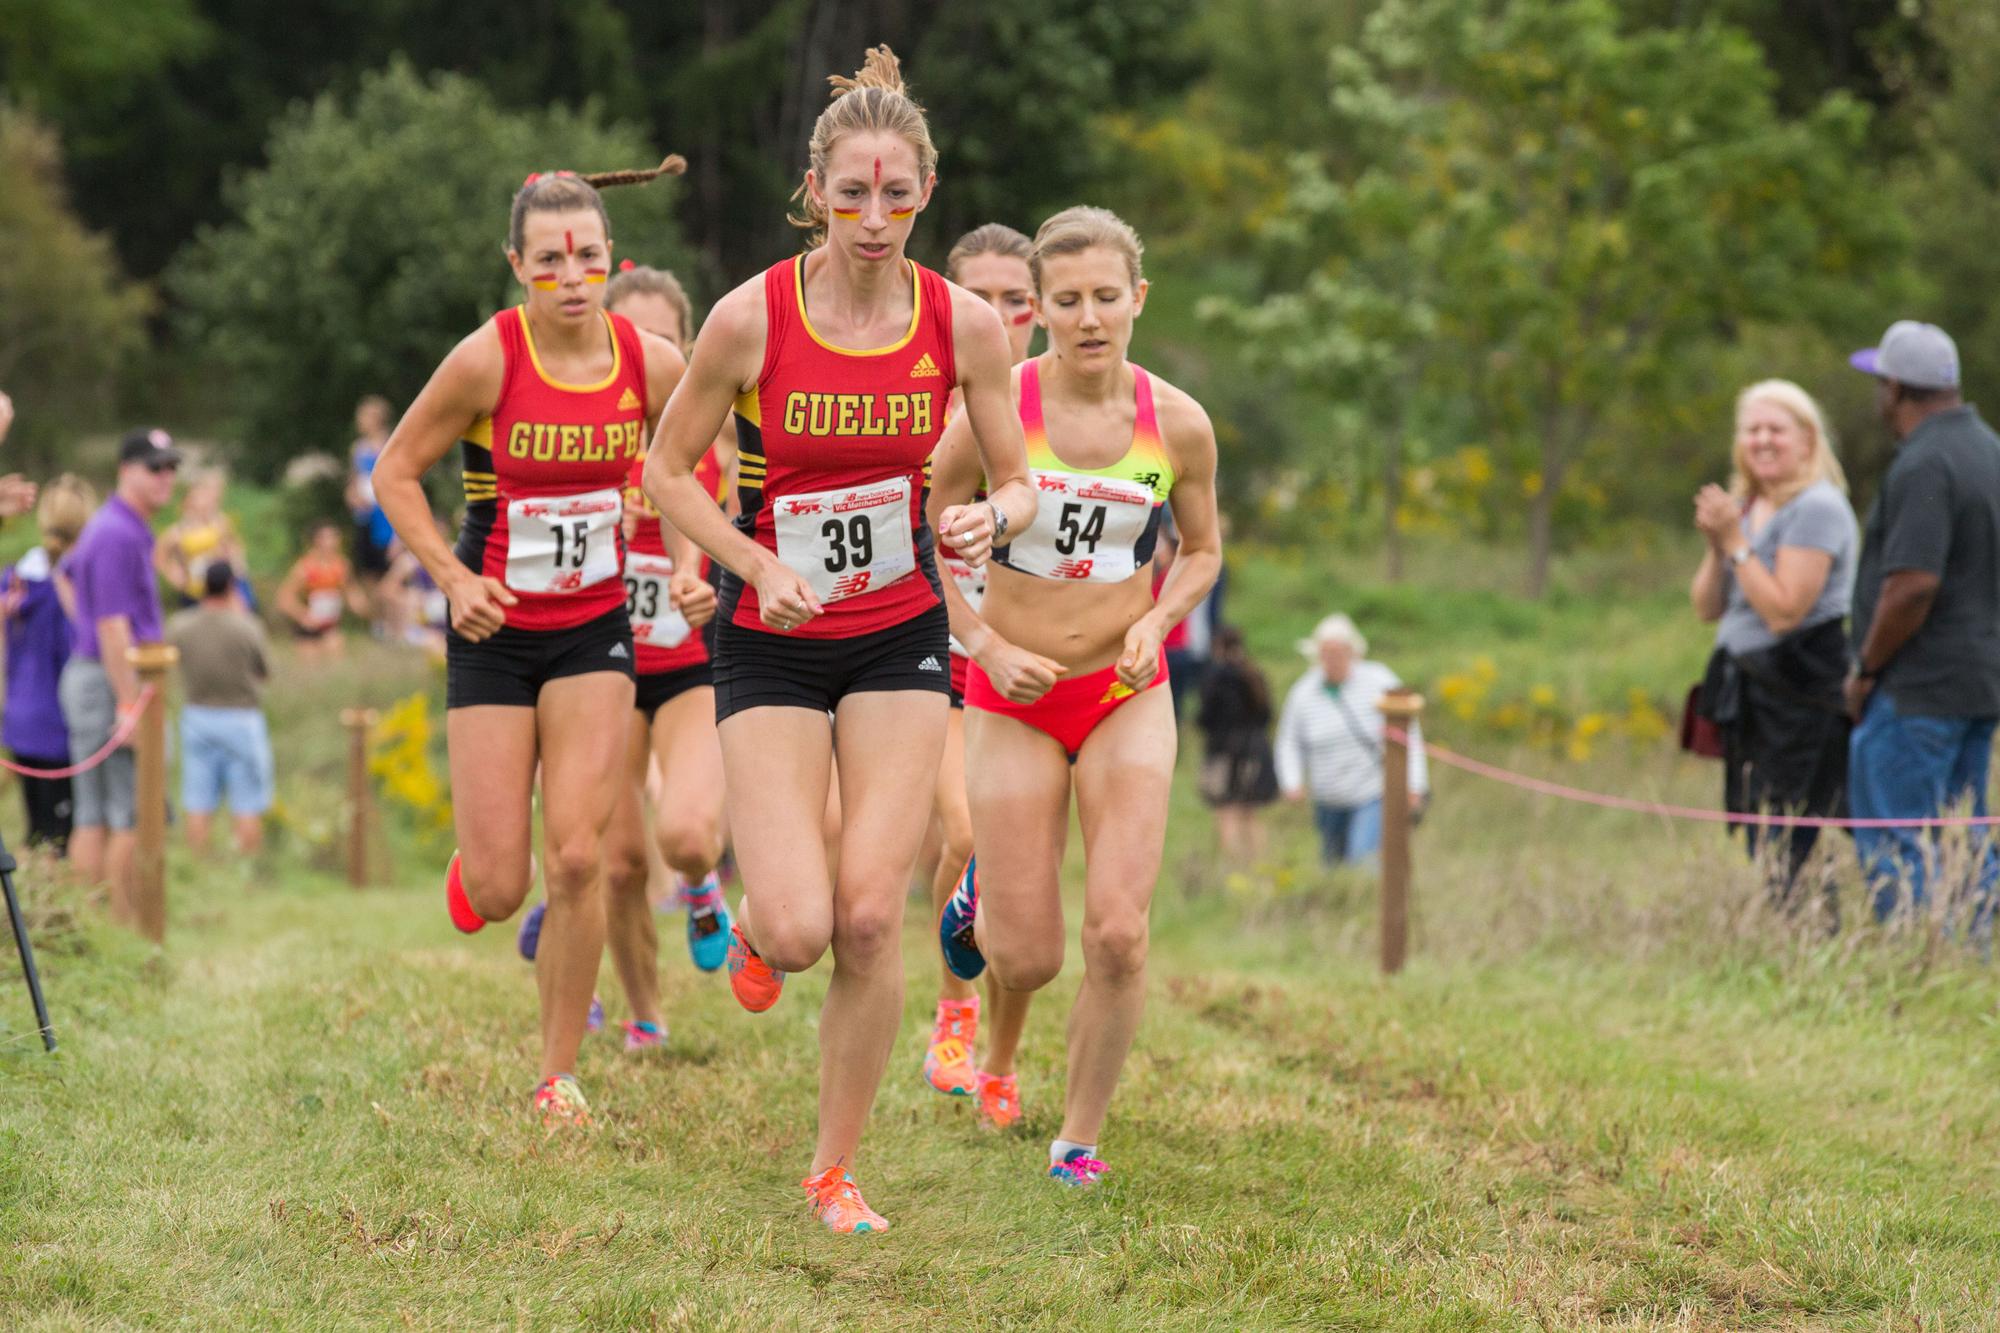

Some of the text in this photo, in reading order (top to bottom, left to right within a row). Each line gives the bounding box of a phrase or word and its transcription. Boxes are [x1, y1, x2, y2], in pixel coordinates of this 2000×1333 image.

[910, 368, 941, 378] adidas
[784, 390, 933, 436] GUELPH
[509, 419, 640, 462] GUELPH
[835, 504, 847, 512] Vic
[847, 497, 882, 510] Matthews
[550, 521, 589, 568] 15
[821, 514, 873, 573] 39
[1055, 502, 1107, 555] 54
